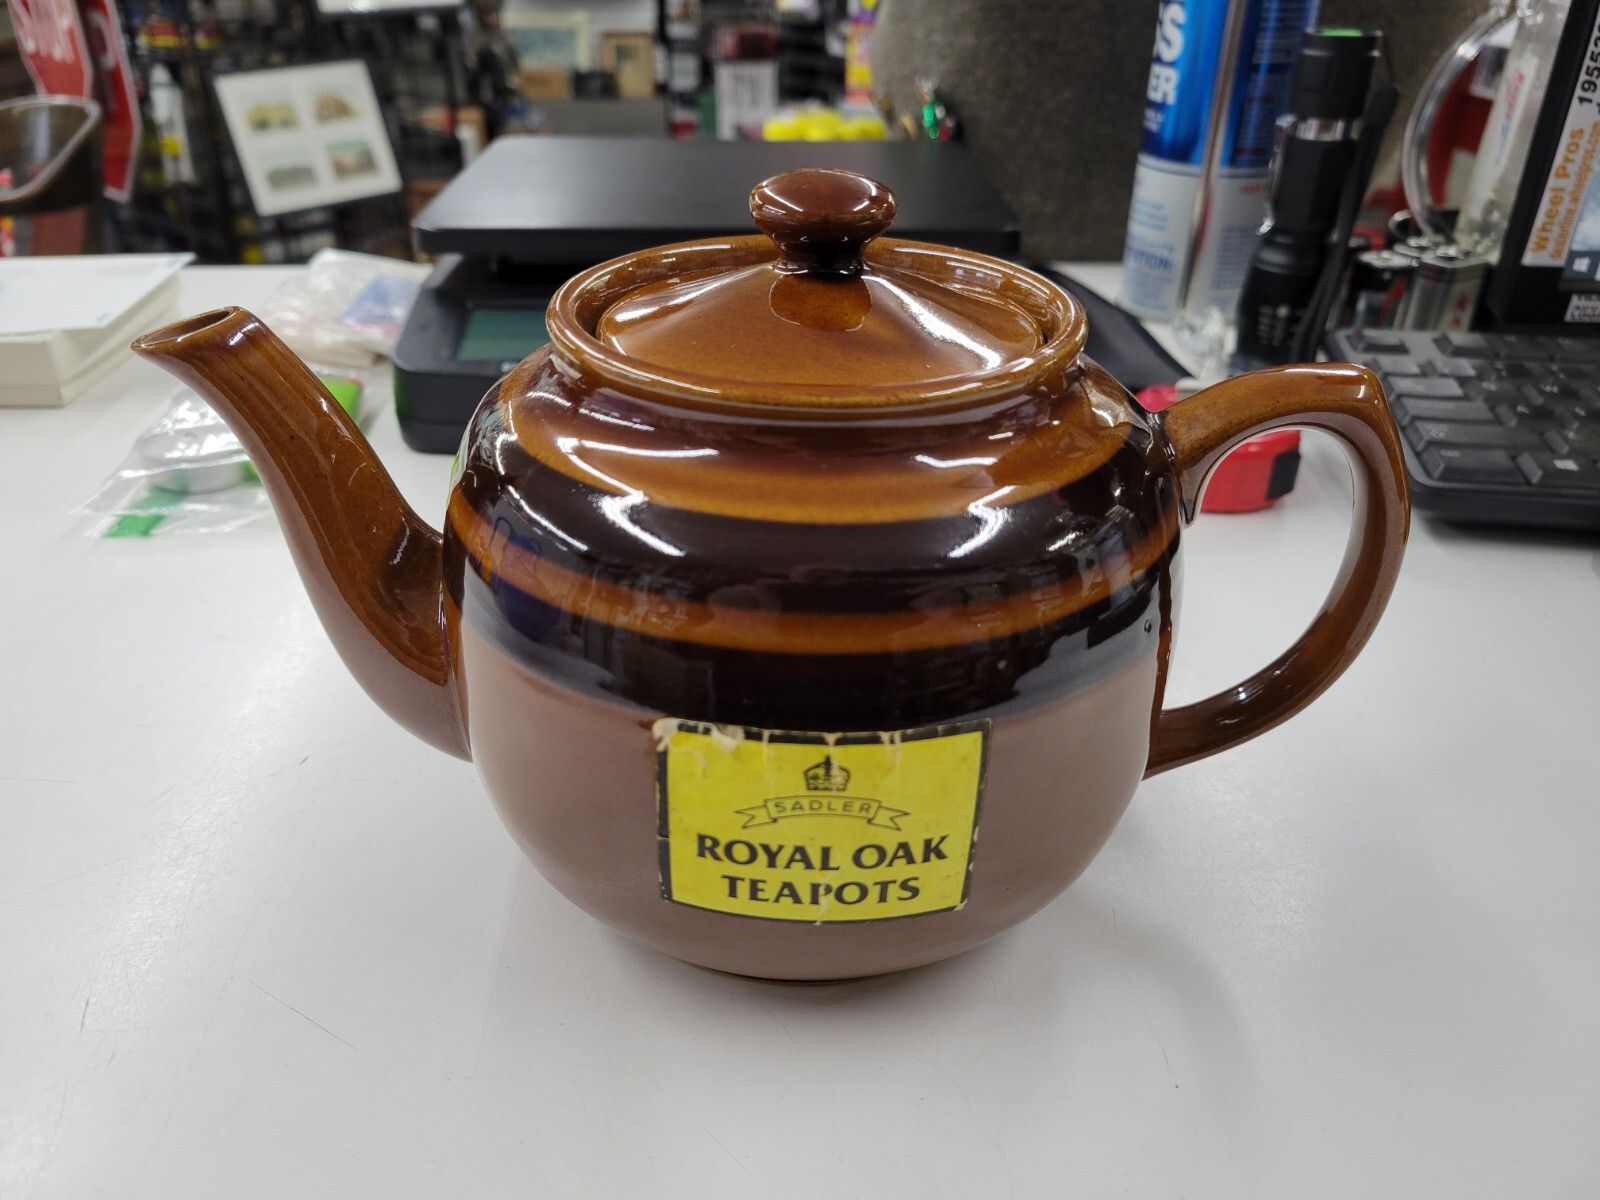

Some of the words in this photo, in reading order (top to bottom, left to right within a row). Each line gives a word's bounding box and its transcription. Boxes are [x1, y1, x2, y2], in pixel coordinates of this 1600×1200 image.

[1530, 186, 1566, 253] Wheel
[1554, 127, 1585, 179] Pros
[774, 799, 871, 814] SADLER
[696, 832, 841, 871] ROYAL
[852, 834, 949, 869] OAK
[721, 874, 920, 905] TEAPOTS
